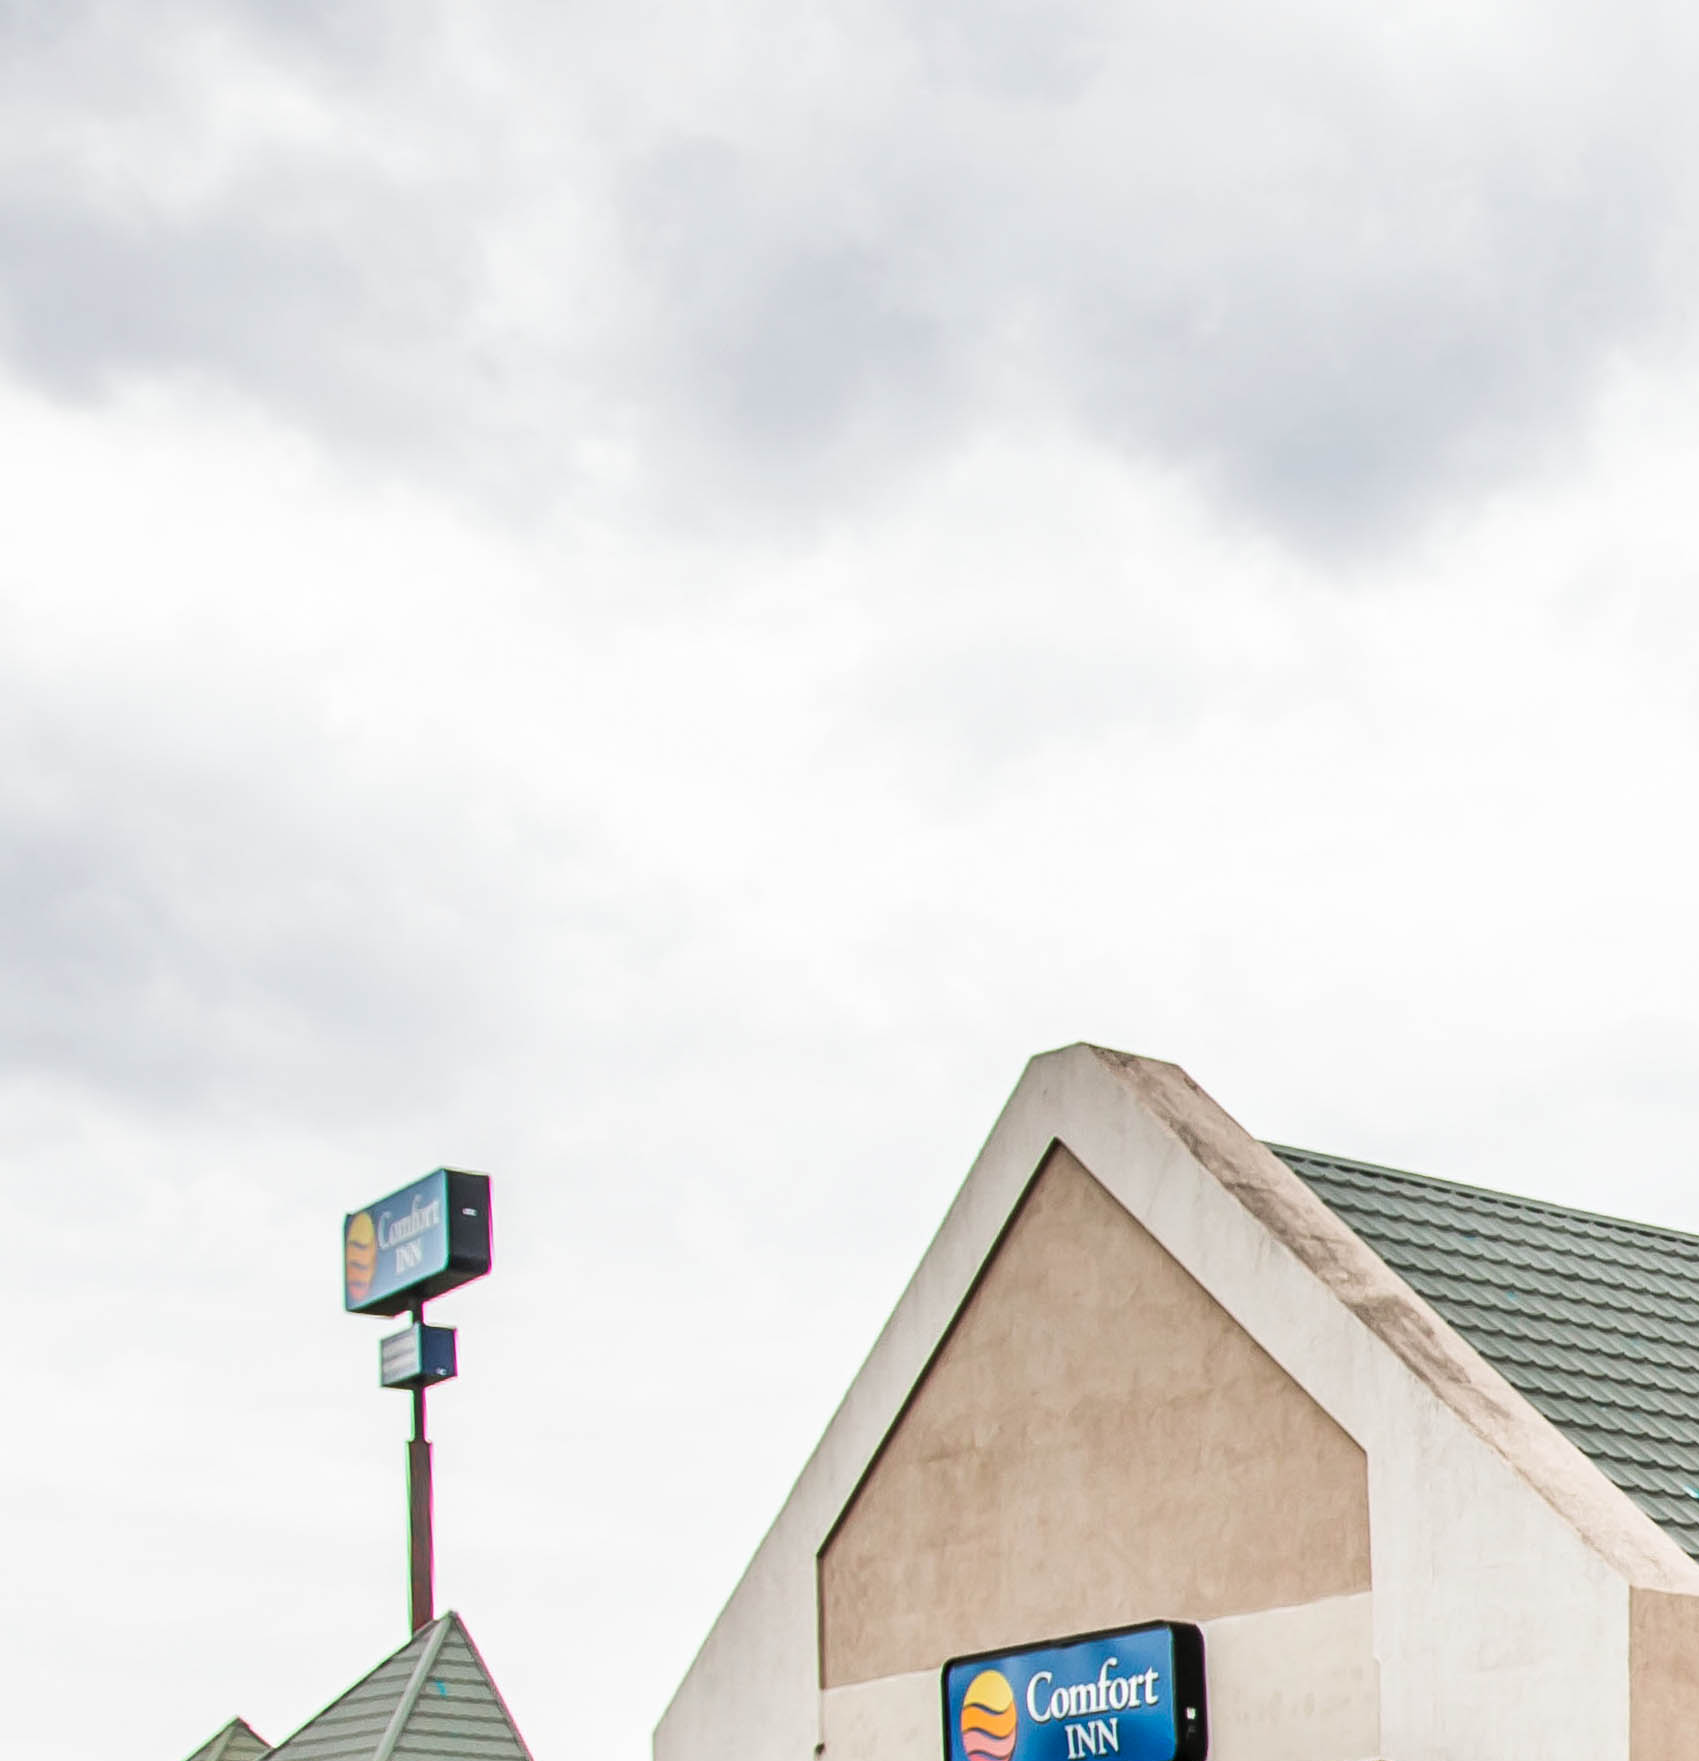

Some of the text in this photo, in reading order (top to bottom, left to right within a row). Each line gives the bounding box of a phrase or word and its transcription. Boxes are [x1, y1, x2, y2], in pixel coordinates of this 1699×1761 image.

[377, 1194, 440, 1250] Comfort
[396, 1240, 423, 1273] INN
[1027, 1657, 1160, 1722] Comfort
[1064, 1717, 1120, 1760] INN
